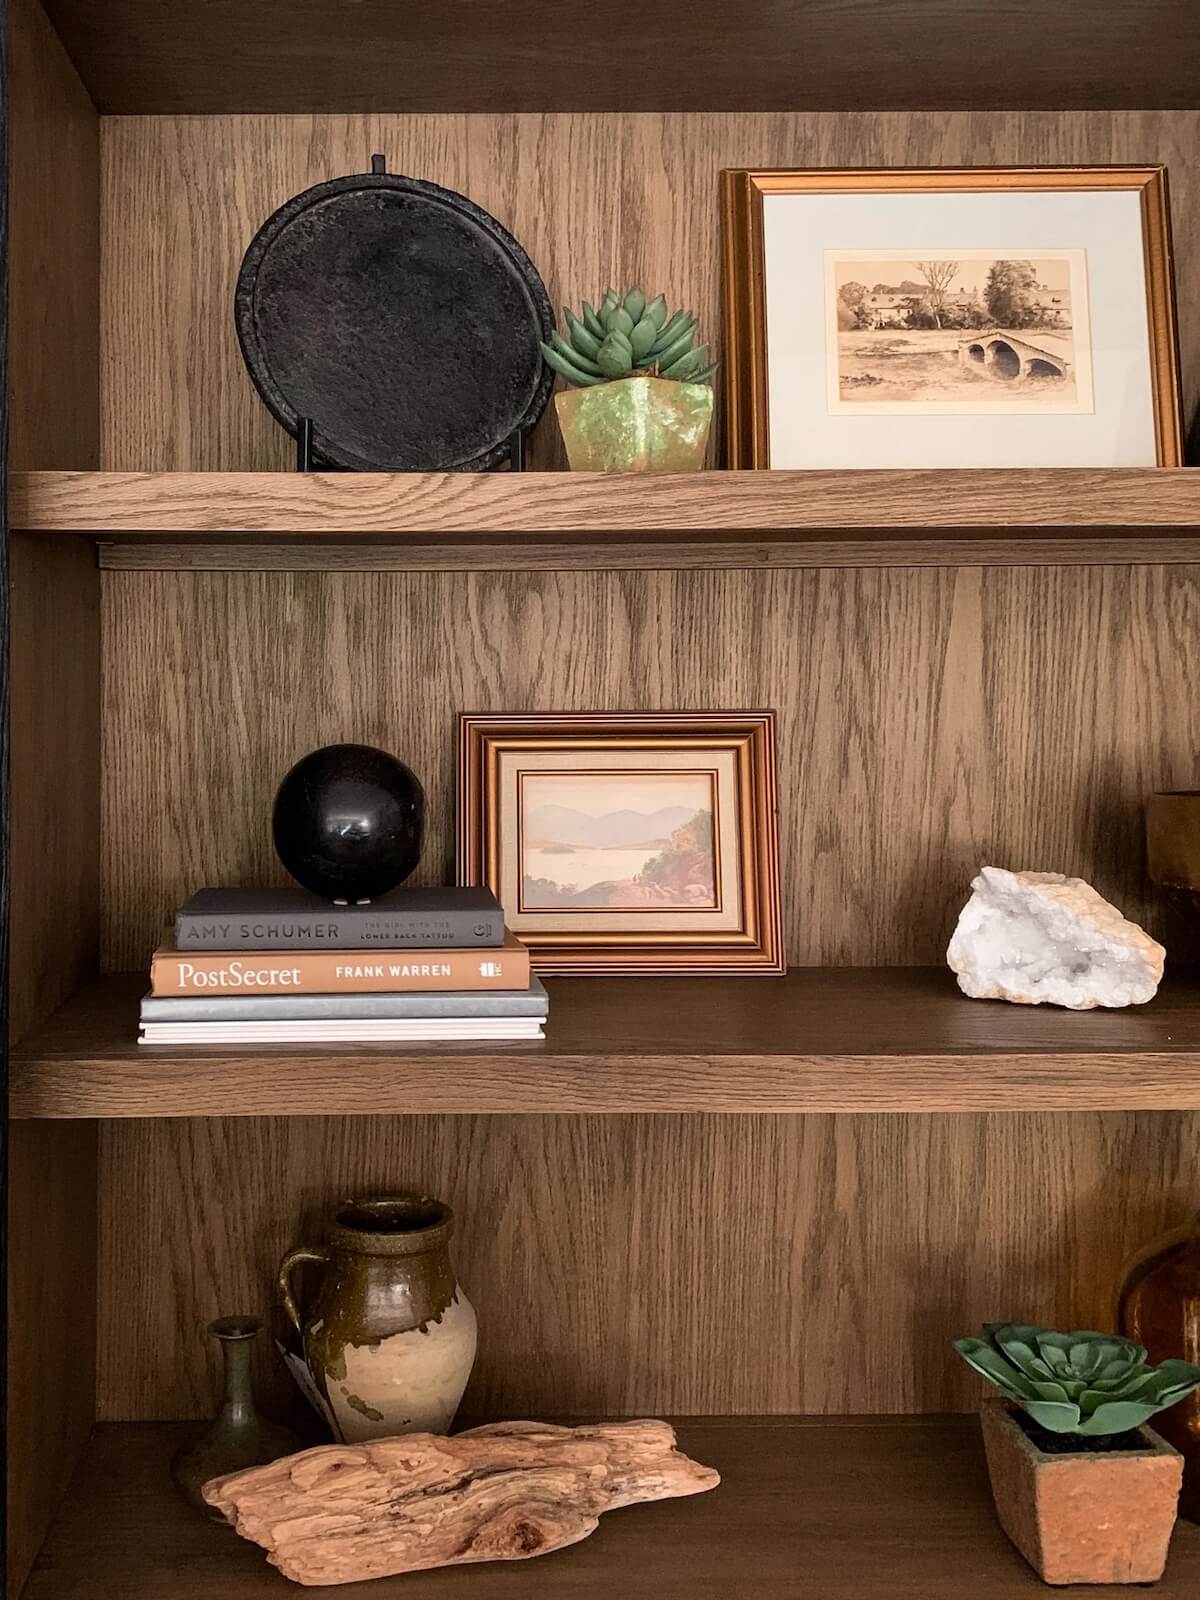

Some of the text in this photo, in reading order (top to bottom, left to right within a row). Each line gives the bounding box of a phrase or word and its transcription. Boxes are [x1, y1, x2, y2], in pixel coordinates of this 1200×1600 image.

[188, 923, 339, 939] AMY SCHUMER
[365, 921, 380, 929] THE
[360, 932, 390, 940] LOWER
[176, 961, 302, 988] PostSecret
[335, 964, 452, 978] FRANK WARREN
